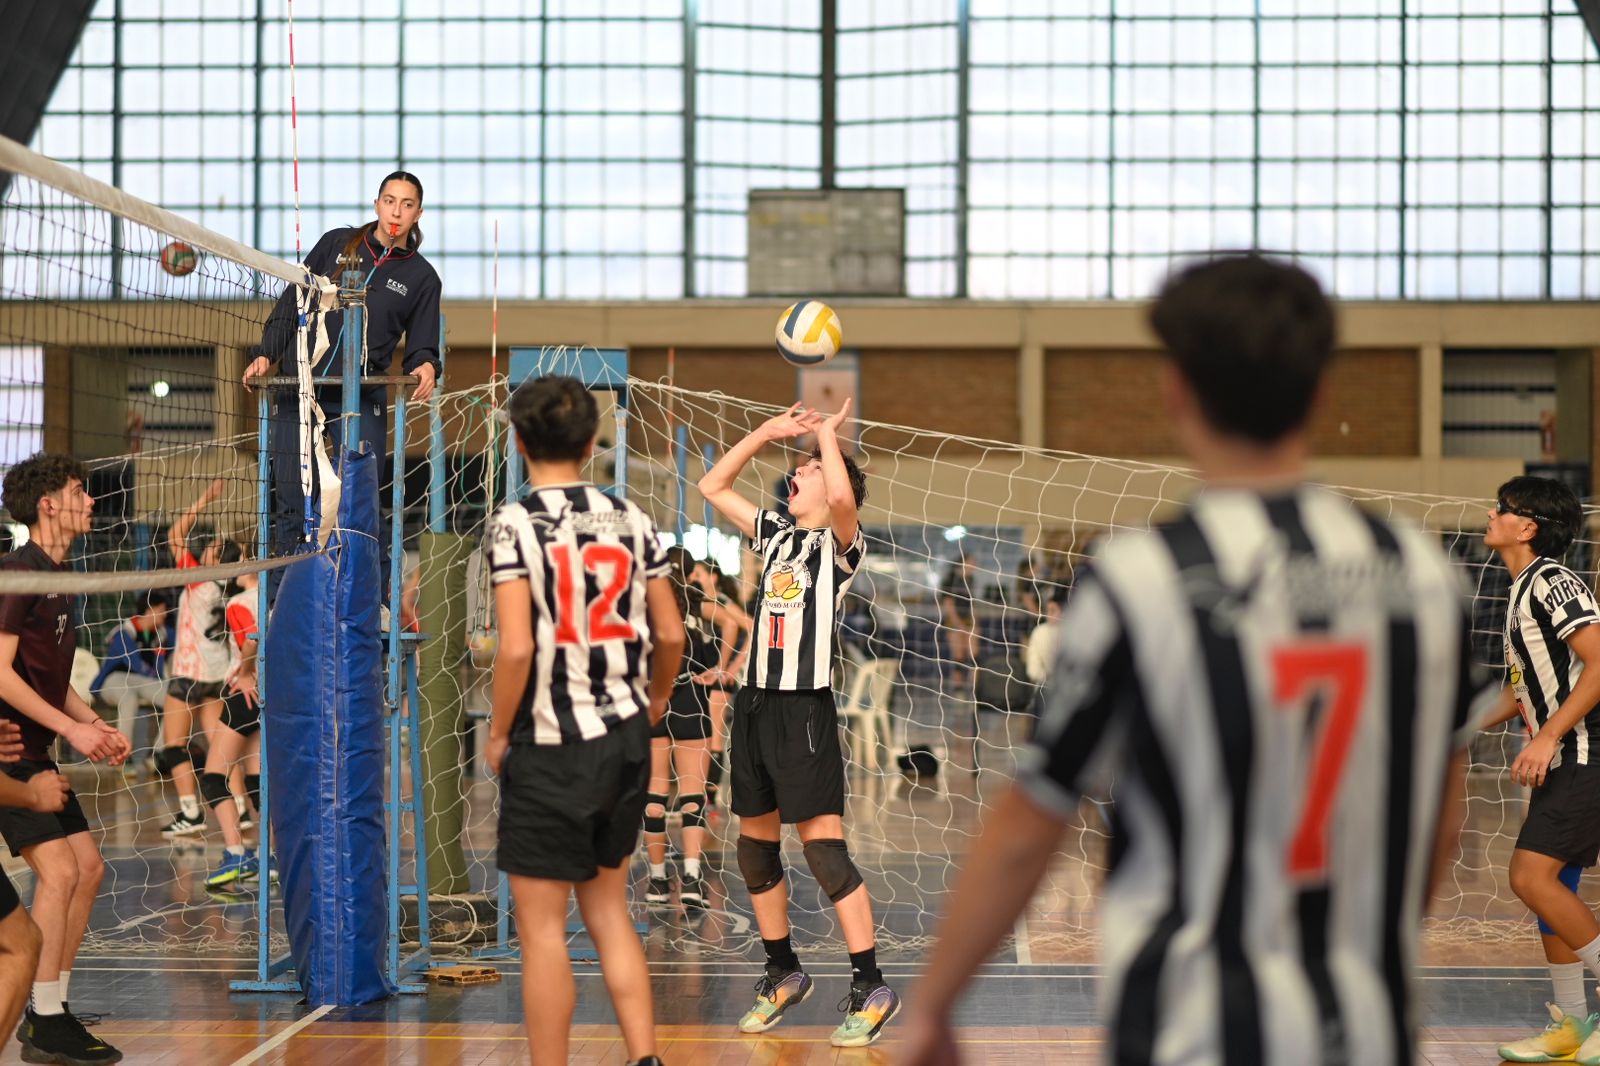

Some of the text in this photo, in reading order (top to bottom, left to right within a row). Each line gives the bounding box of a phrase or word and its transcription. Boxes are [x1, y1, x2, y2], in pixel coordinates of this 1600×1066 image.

[546, 542, 638, 646] 12
[768, 615, 785, 649] 11
[1265, 638, 1370, 882] 7
